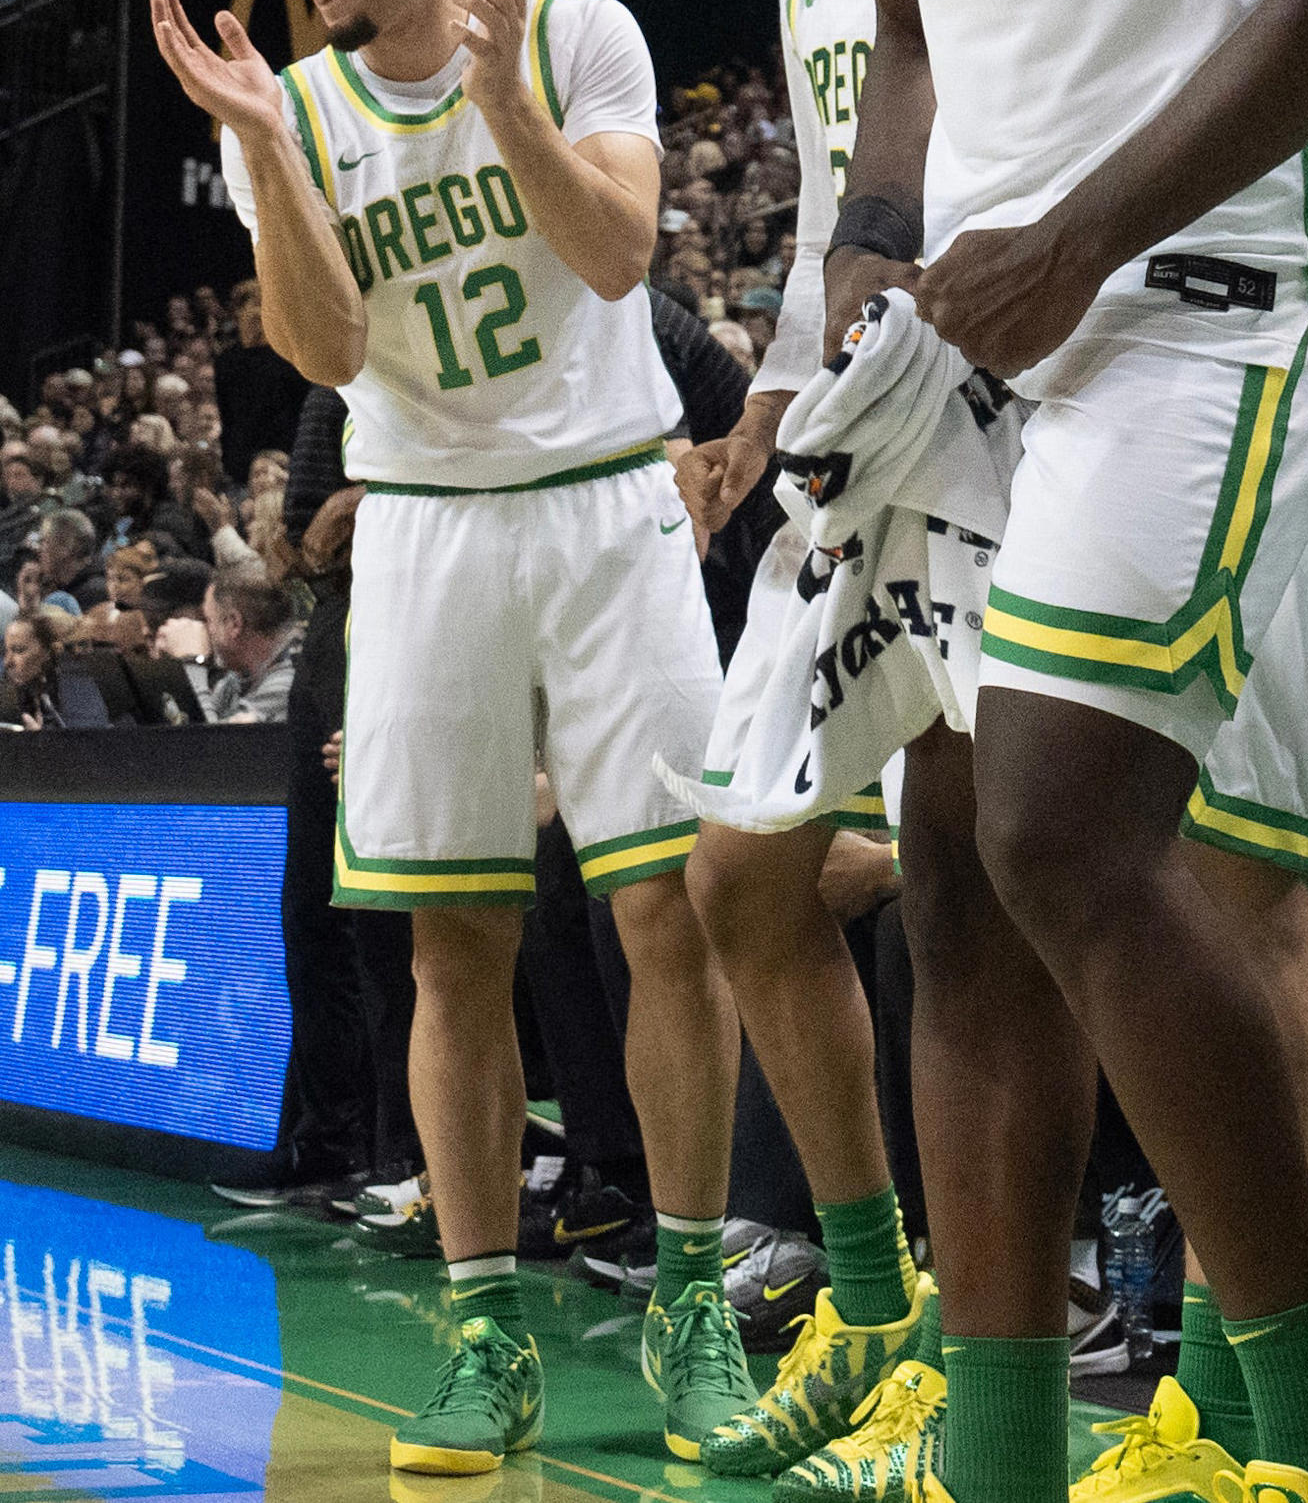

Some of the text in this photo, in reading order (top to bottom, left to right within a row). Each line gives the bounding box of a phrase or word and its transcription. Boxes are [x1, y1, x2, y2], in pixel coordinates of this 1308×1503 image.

[339, 163, 530, 295] OREGO
[1237, 276, 1257, 297] 52
[414, 262, 543, 391] 12
[0, 867, 203, 1069] -FREE
